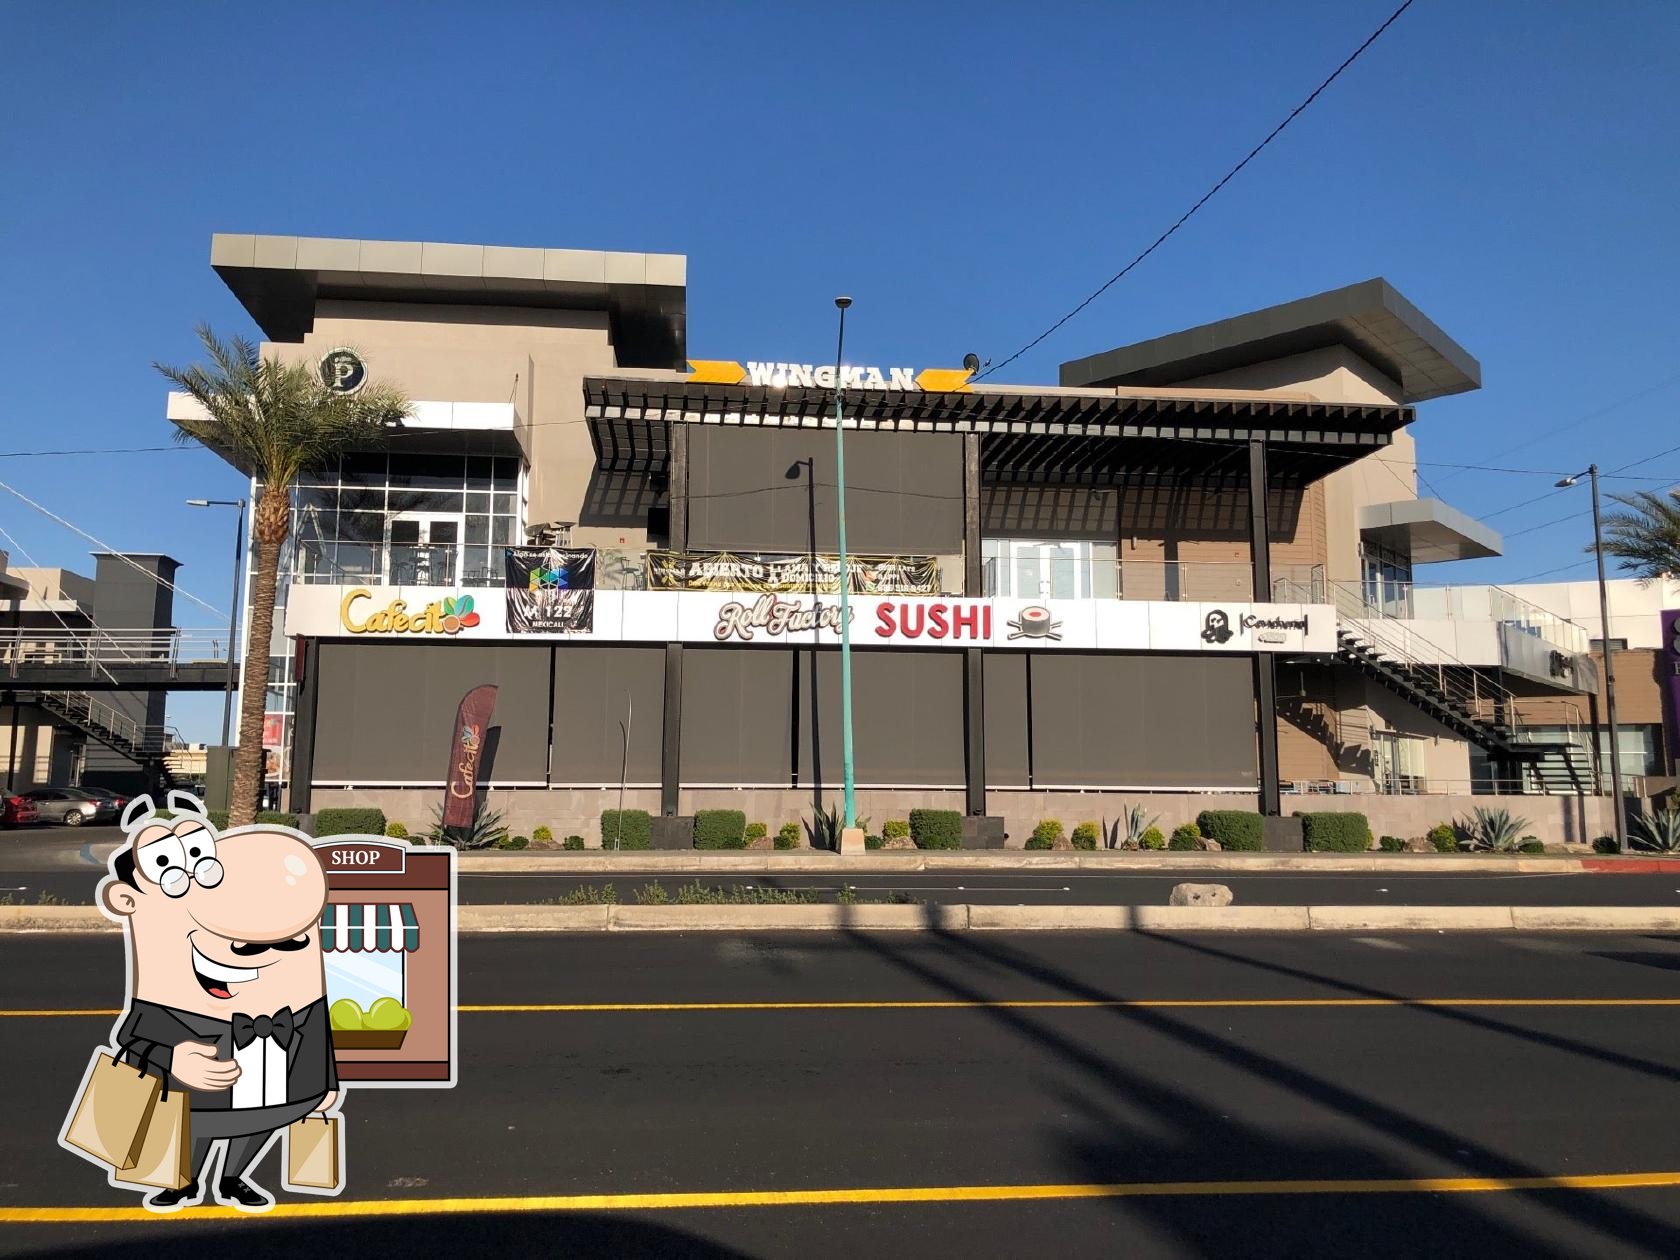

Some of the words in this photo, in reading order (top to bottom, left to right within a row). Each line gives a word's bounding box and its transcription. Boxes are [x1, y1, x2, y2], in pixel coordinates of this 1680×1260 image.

[747, 361, 914, 390] WINGMAN
[713, 593, 777, 640] Roll
[874, 601, 992, 640] SUSHI
